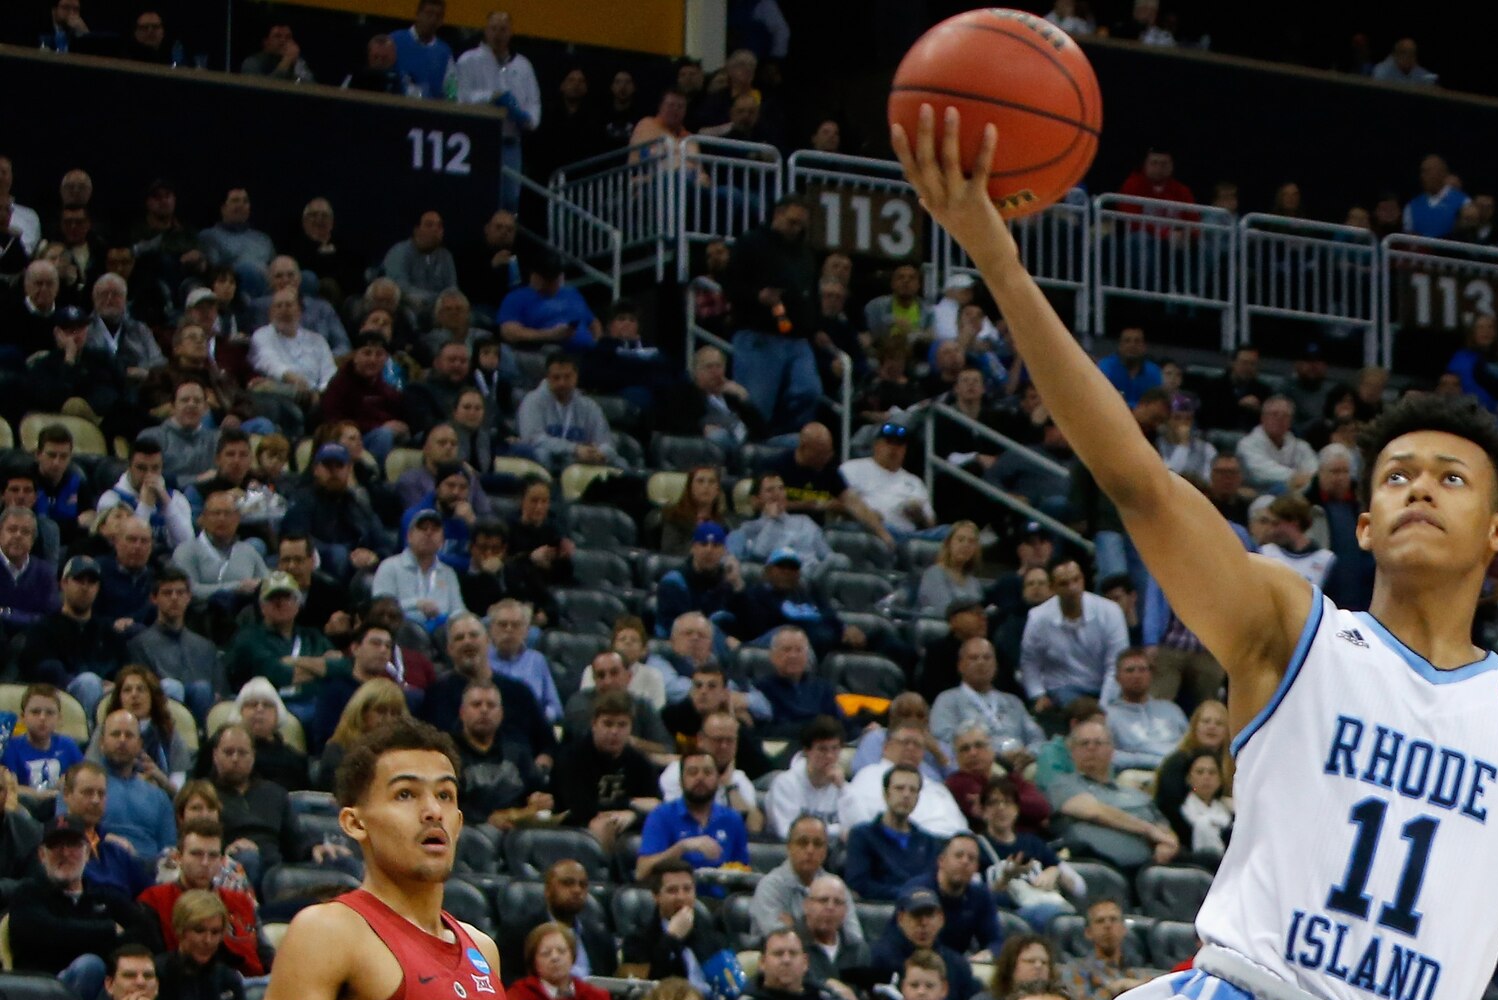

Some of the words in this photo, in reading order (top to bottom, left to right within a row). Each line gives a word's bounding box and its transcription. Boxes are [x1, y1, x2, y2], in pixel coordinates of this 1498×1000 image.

[406, 127, 471, 174] 112
[820, 192, 915, 257] 113
[1410, 273, 1496, 328] 113
[1324, 714, 1498, 824] RHODE
[1325, 794, 1440, 938] 11
